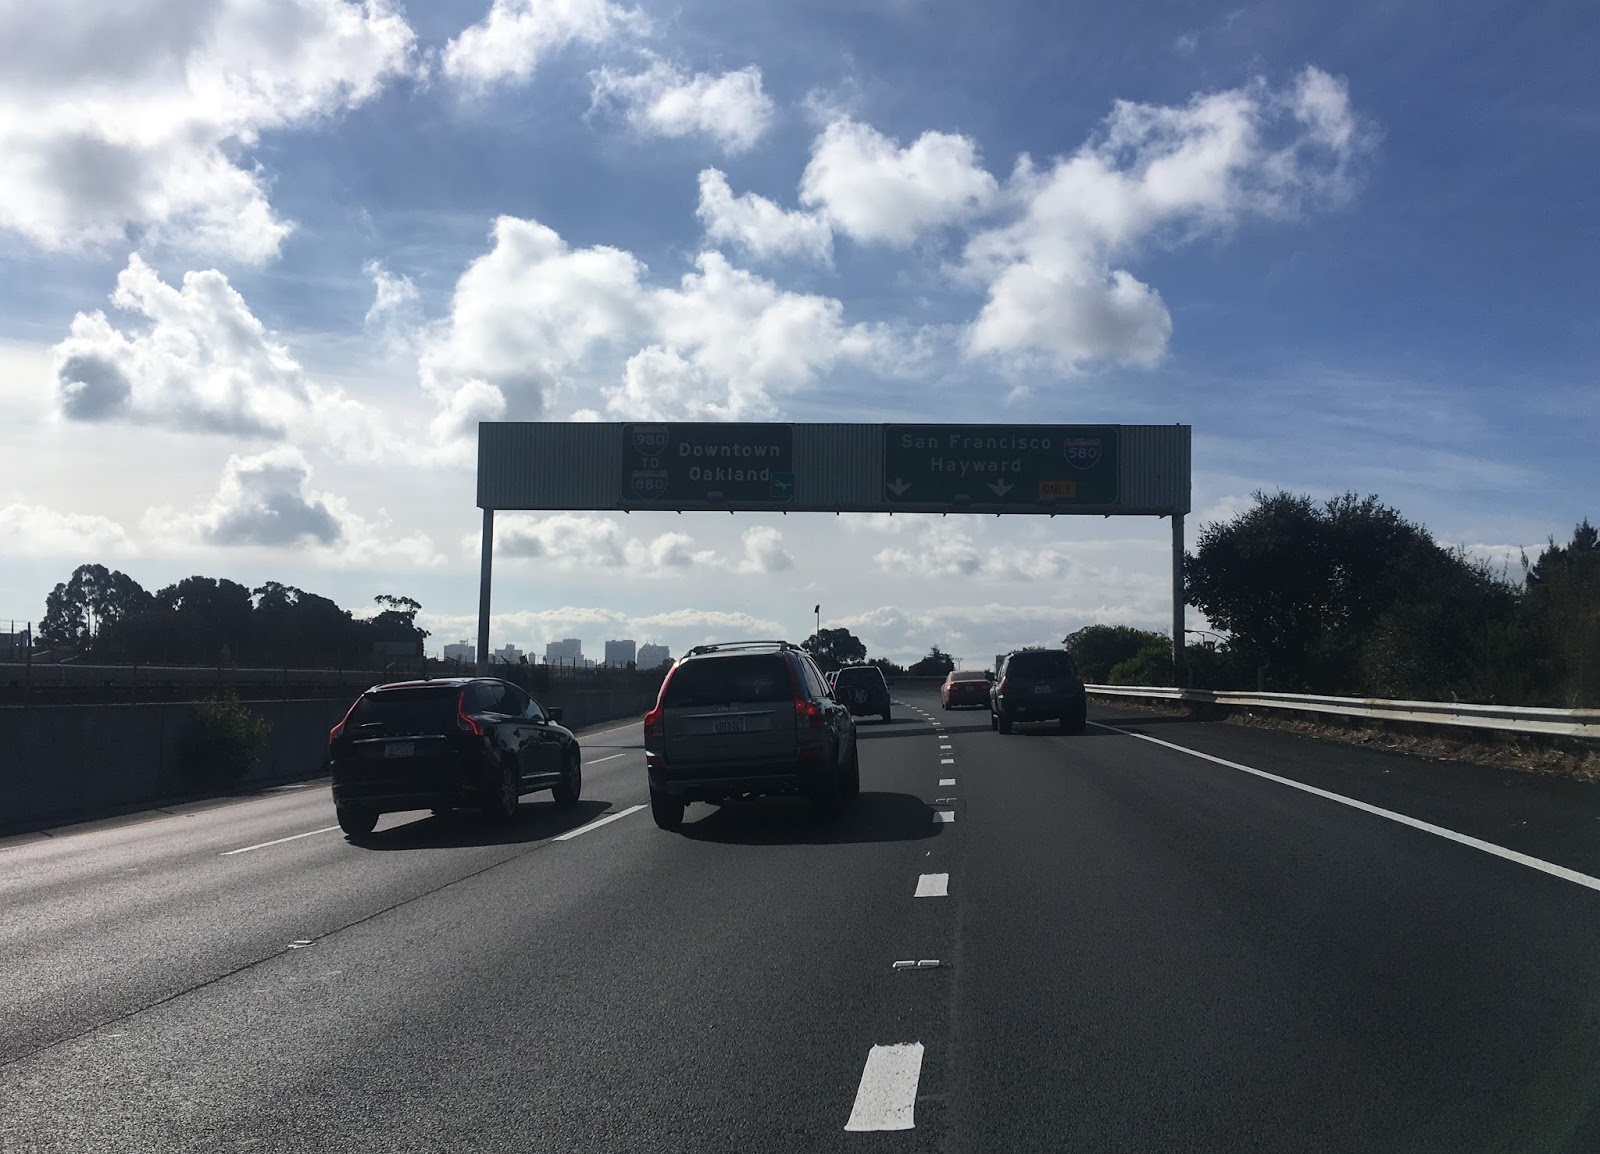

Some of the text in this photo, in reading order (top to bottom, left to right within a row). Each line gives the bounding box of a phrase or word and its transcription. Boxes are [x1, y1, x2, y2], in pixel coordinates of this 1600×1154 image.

[637, 434, 665, 445] 980
[902, 434, 938, 449] San
[950, 434, 1051, 449] Francisco
[679, 442, 780, 457] Downtown
[1068, 447, 1097, 458] 580
[642, 457, 659, 468] TO
[931, 457, 1021, 477] Hayward
[689, 467, 770, 481] Oakland
[1042, 484, 1072, 495] ONLY
